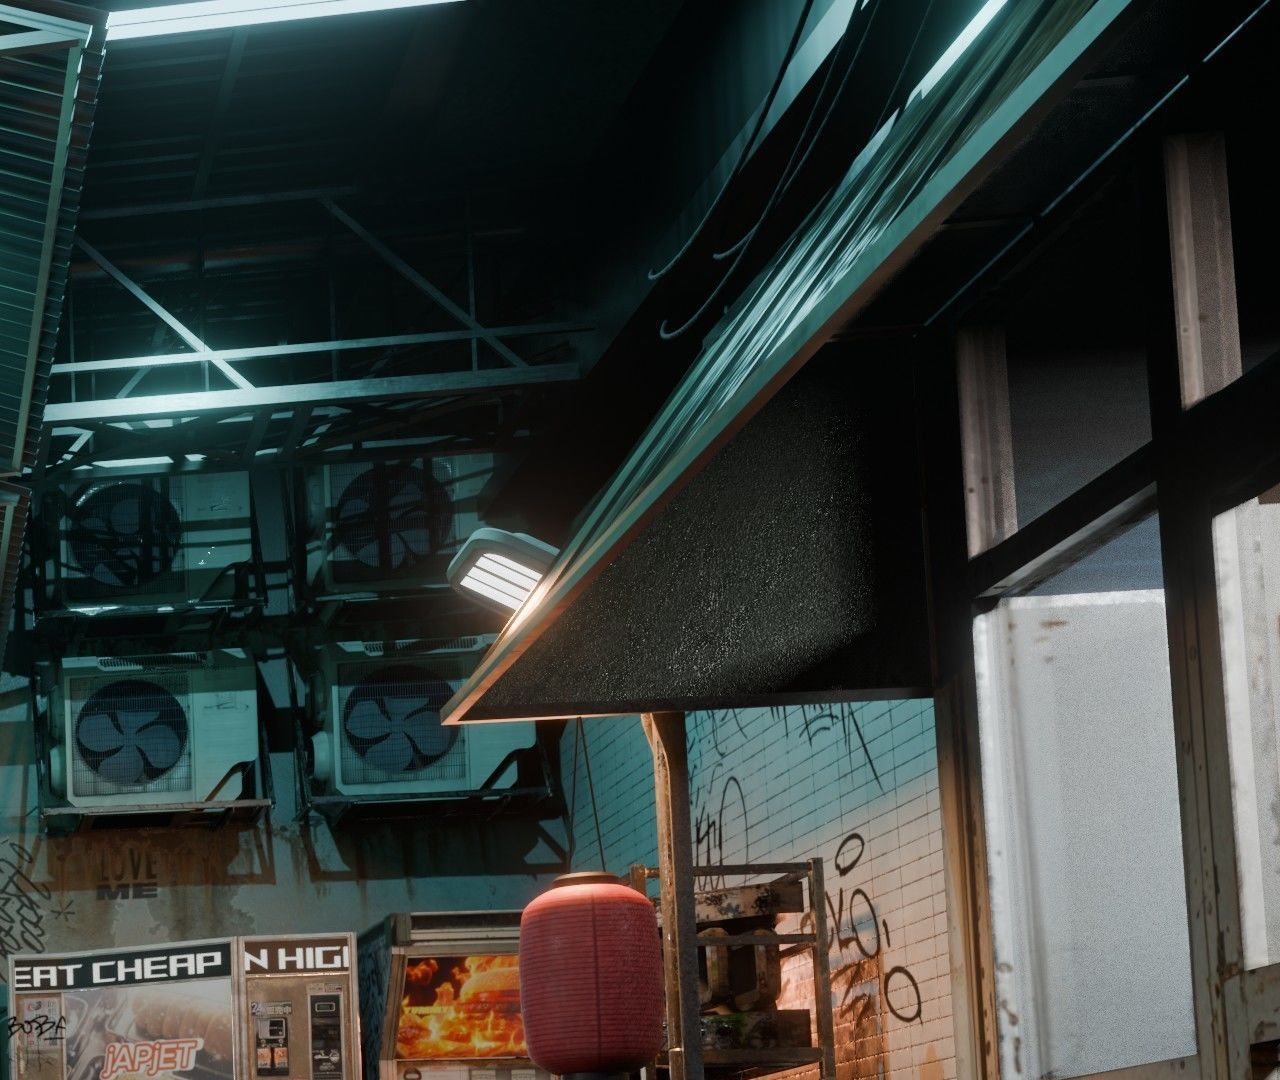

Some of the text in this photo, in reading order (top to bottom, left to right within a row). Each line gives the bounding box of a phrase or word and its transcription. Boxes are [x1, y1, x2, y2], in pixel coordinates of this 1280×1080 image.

[96, 882, 158, 901] ME
[14, 951, 222, 989] EAT CHEAP
